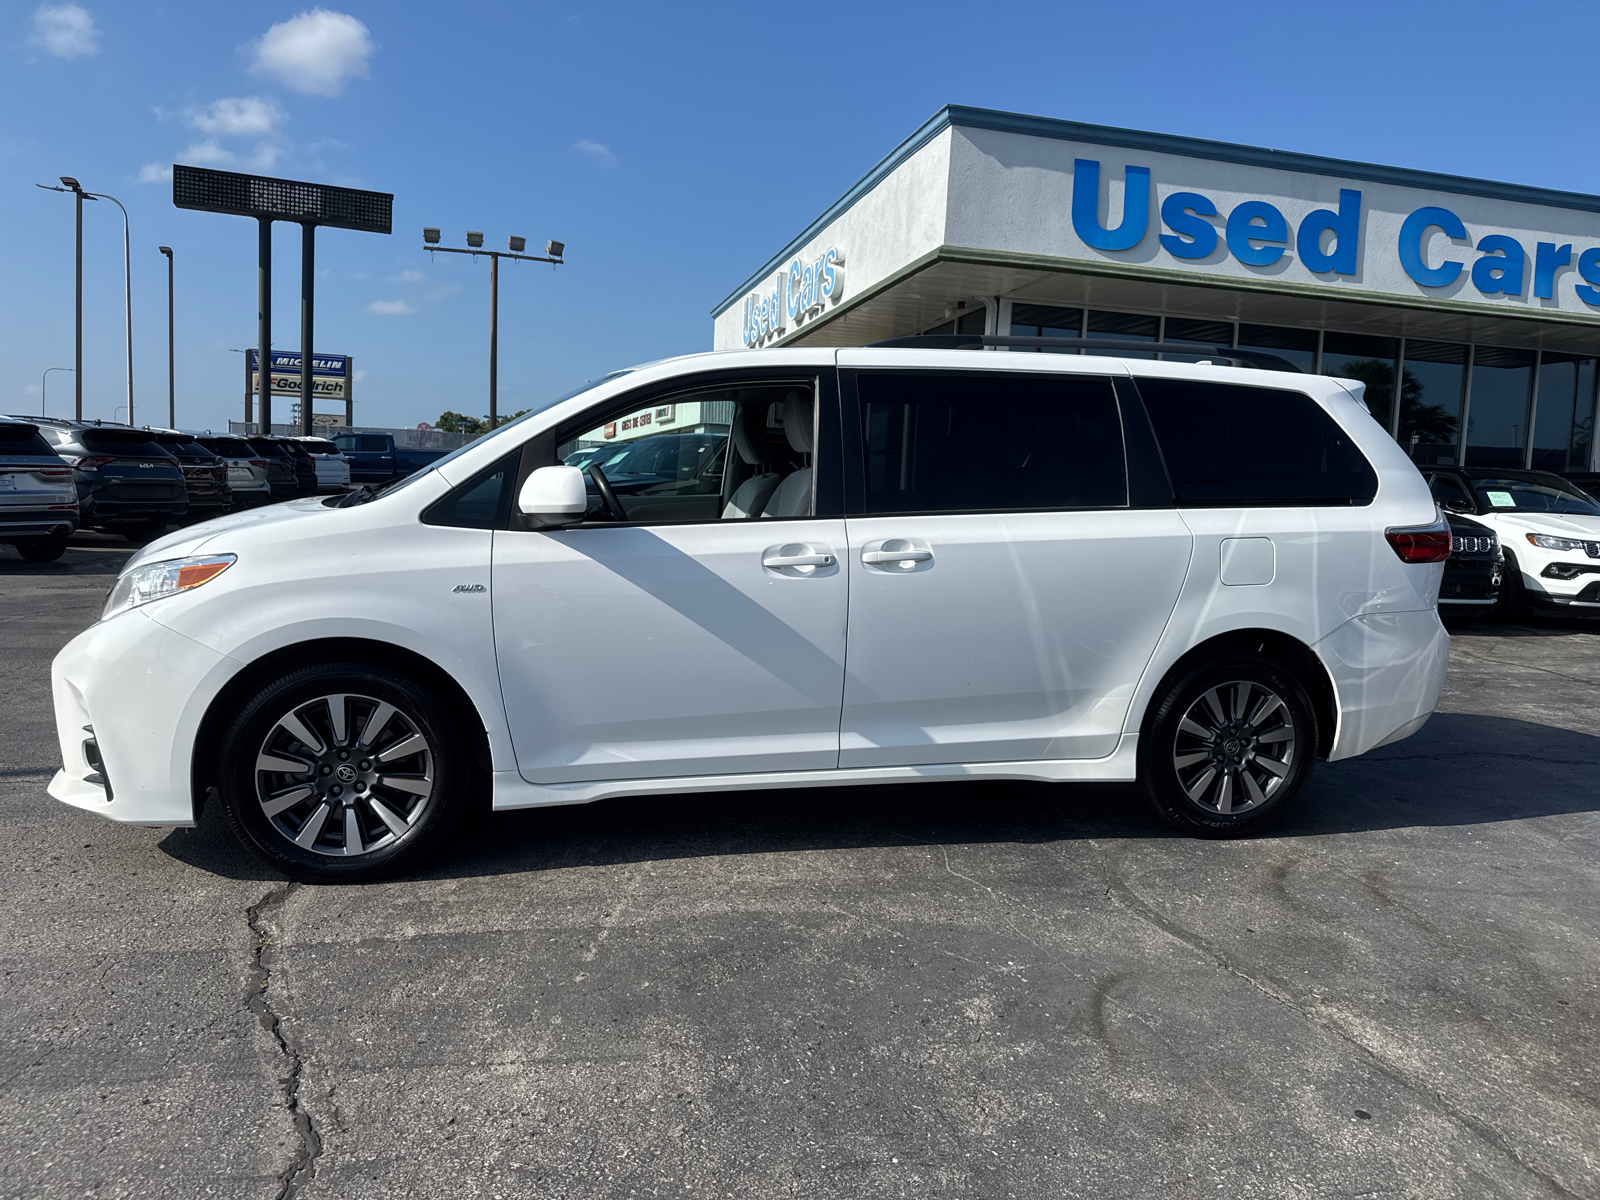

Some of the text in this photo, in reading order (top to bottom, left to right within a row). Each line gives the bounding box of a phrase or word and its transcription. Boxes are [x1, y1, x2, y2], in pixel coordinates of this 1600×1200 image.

[1071, 158, 1362, 275] Used
[742, 247, 840, 347] Used Cars
[276, 357, 342, 368] MICELIN
